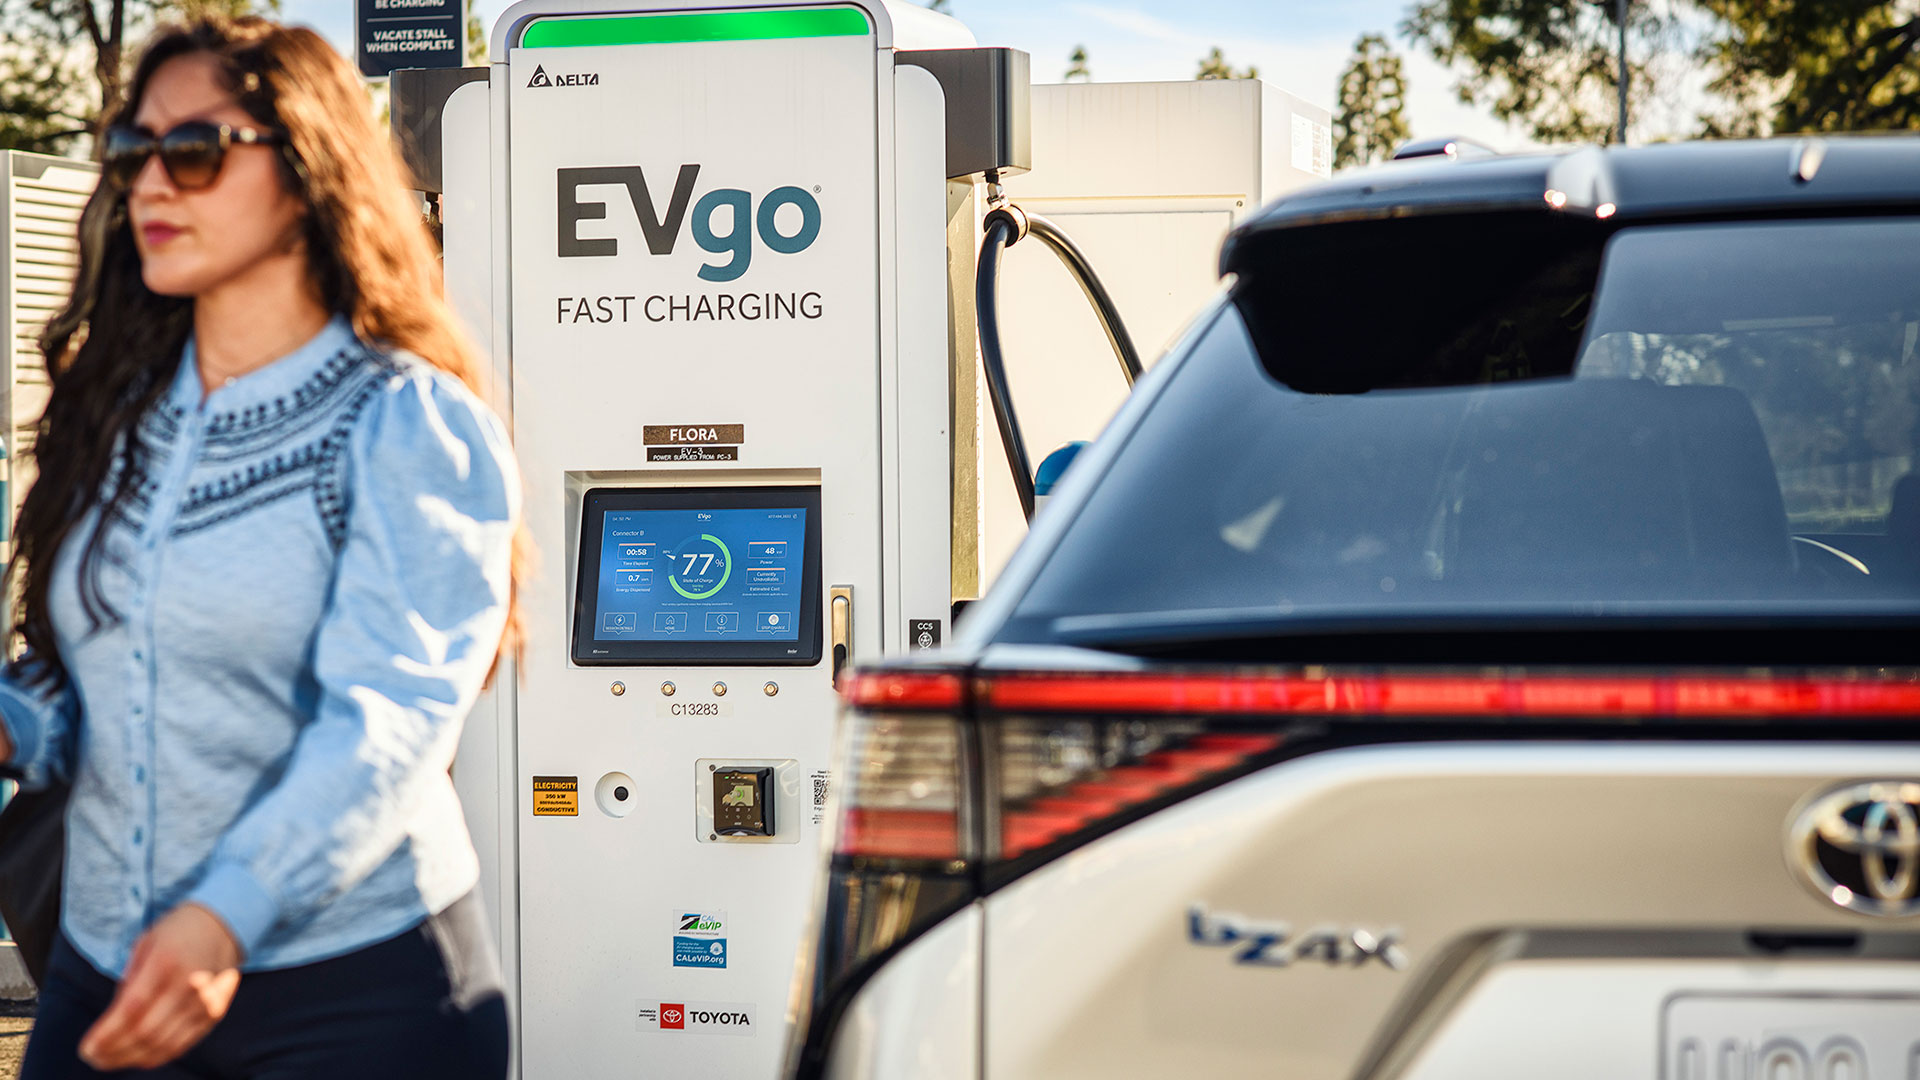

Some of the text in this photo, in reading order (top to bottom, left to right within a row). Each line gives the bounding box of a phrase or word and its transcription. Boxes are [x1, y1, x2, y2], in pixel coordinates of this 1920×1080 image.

[375, 0, 445, 9] BE CHARGING
[373, 28, 447, 41] VACATE STALL
[366, 39, 455, 53] WHEN COMPLETE
[556, 73, 599, 87] DELTA
[557, 292, 823, 324] FAST CHARGING
[670, 428, 718, 441] FLORA
[680, 447, 704, 456] EV-3
[626, 548, 647, 556] 00:58
[765, 546, 775, 555] 48
[628, 574, 640, 582] 0.7
[917, 622, 934, 631] CCS
[671, 703, 719, 716] C13283
[534, 782, 577, 790] ELECTRICITY
[699, 921, 722, 931] eVIP
[675, 953, 725, 965] CALeVIP.org
[689, 1011, 750, 1026] TOYOTA
